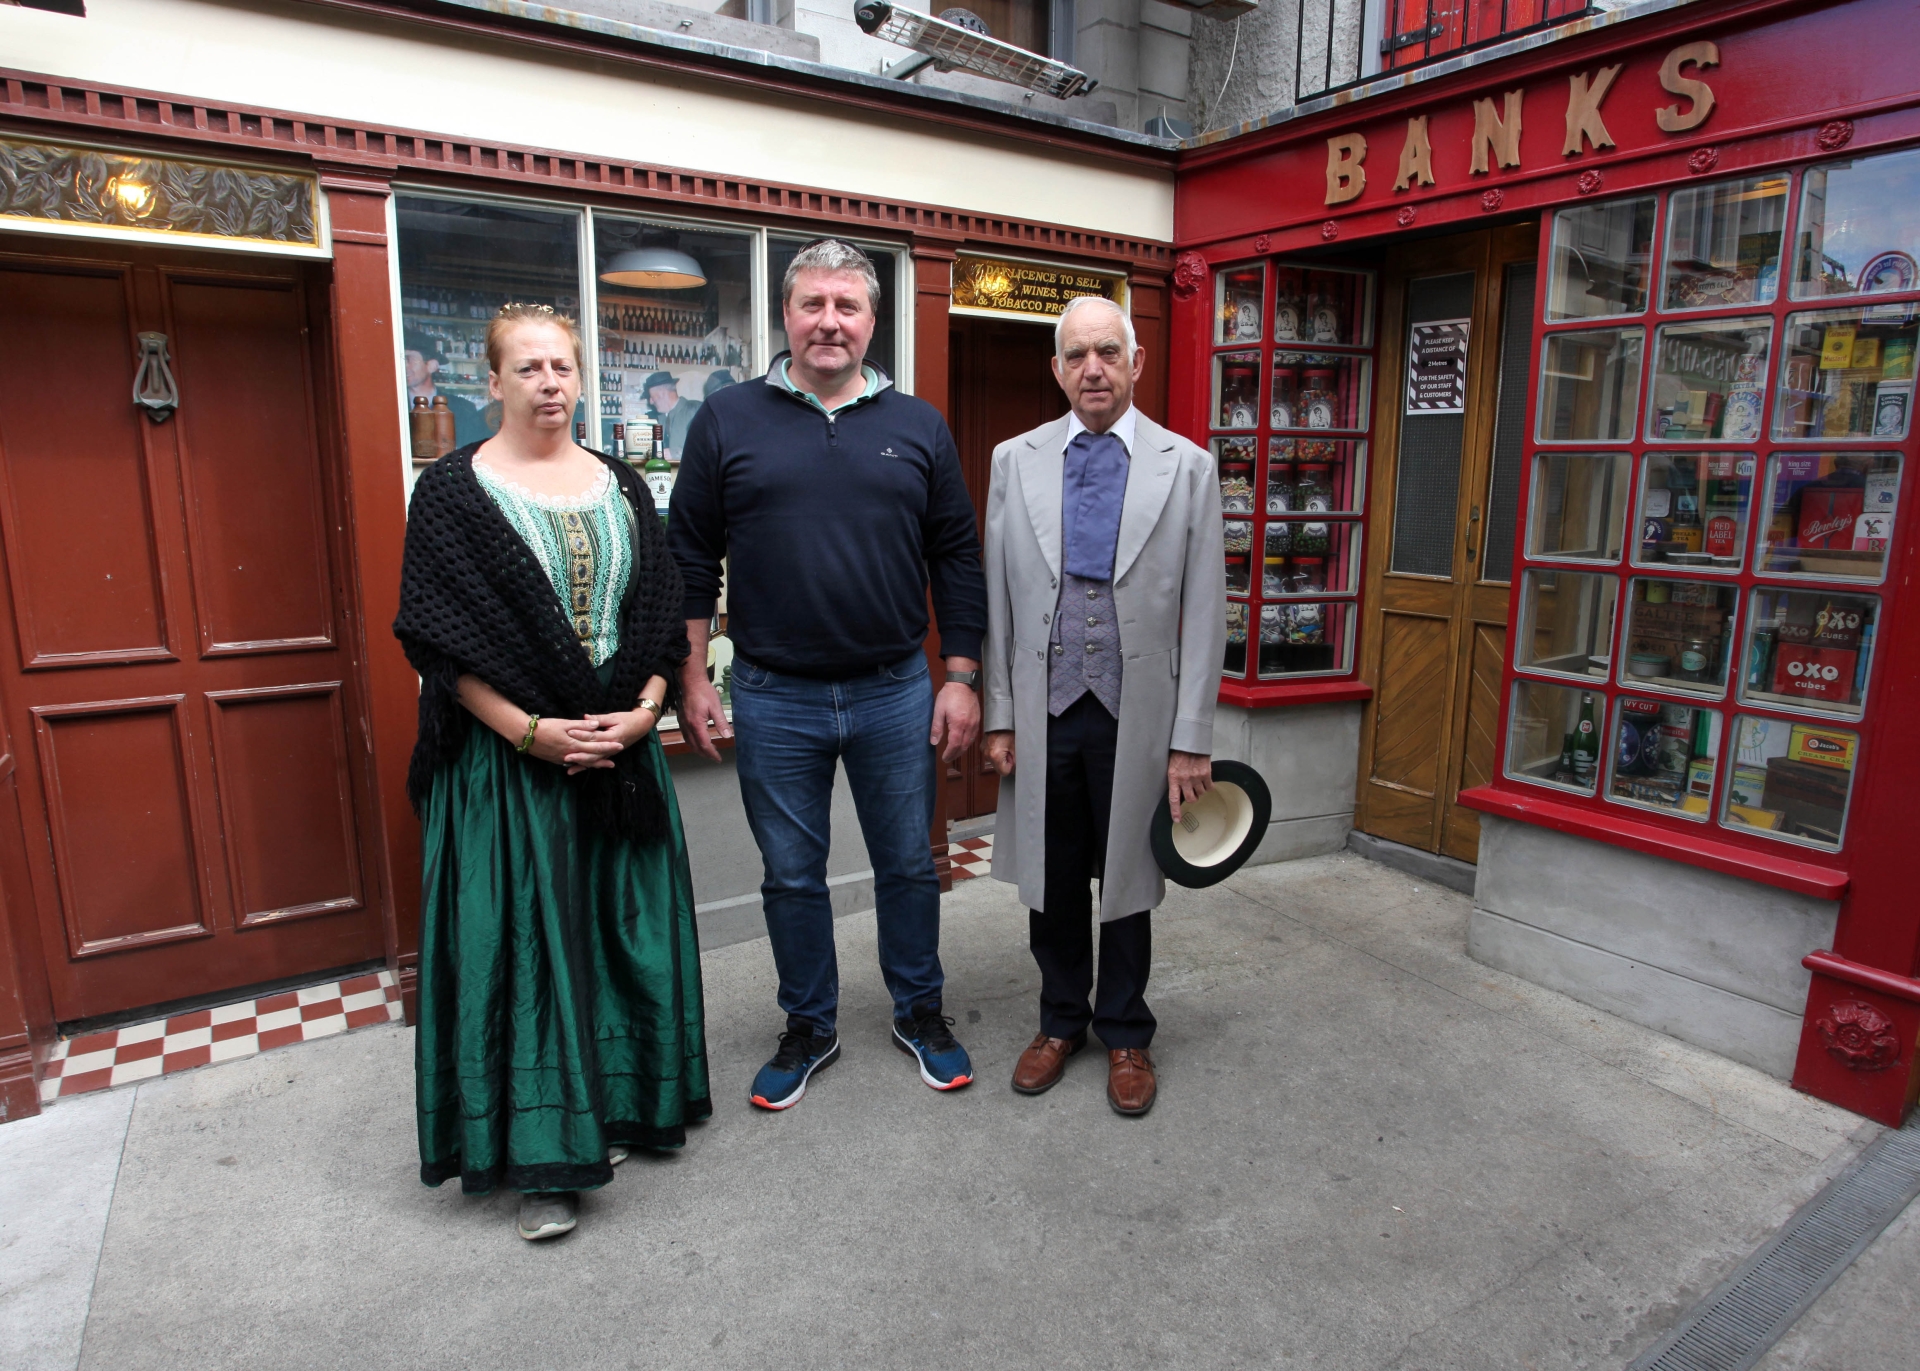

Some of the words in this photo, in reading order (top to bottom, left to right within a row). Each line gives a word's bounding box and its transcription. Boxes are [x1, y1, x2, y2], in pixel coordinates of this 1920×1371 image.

[1323, 40, 1721, 206] BANKS
[985, 265, 1009, 276] DAY
[1011, 269, 1057, 283] LICENCE
[1060, 274, 1074, 285] TO
[1076, 278, 1102, 289] SELL
[1022, 285, 1060, 300] WINES,
[977, 295, 988, 306] &
[991, 297, 1043, 311] TOBACCO
[1426, 346, 1448, 354] DISTANCE
[1823, 354, 1848, 362] Mustard
[1787, 460, 1800, 468] king
[1800, 460, 1811, 468] size
[1714, 521, 1730, 530] RED
[1709, 530, 1733, 539] LABEL
[1634, 606, 1695, 622] GALTEE
[1816, 610, 1860, 630] OXO
[1779, 625, 1809, 637] OXO
[1820, 632, 1849, 640] CUBES
[1787, 661, 1839, 681] OXO
[1794, 680, 1826, 691] cubes
[1639, 701, 1654, 711] CUT
[1818, 742, 1840, 751] Jacob's
[1797, 750, 1826, 760] CREAM
[1829, 756, 1853, 765] CRAC
[1694, 770, 1711, 781] NEW
